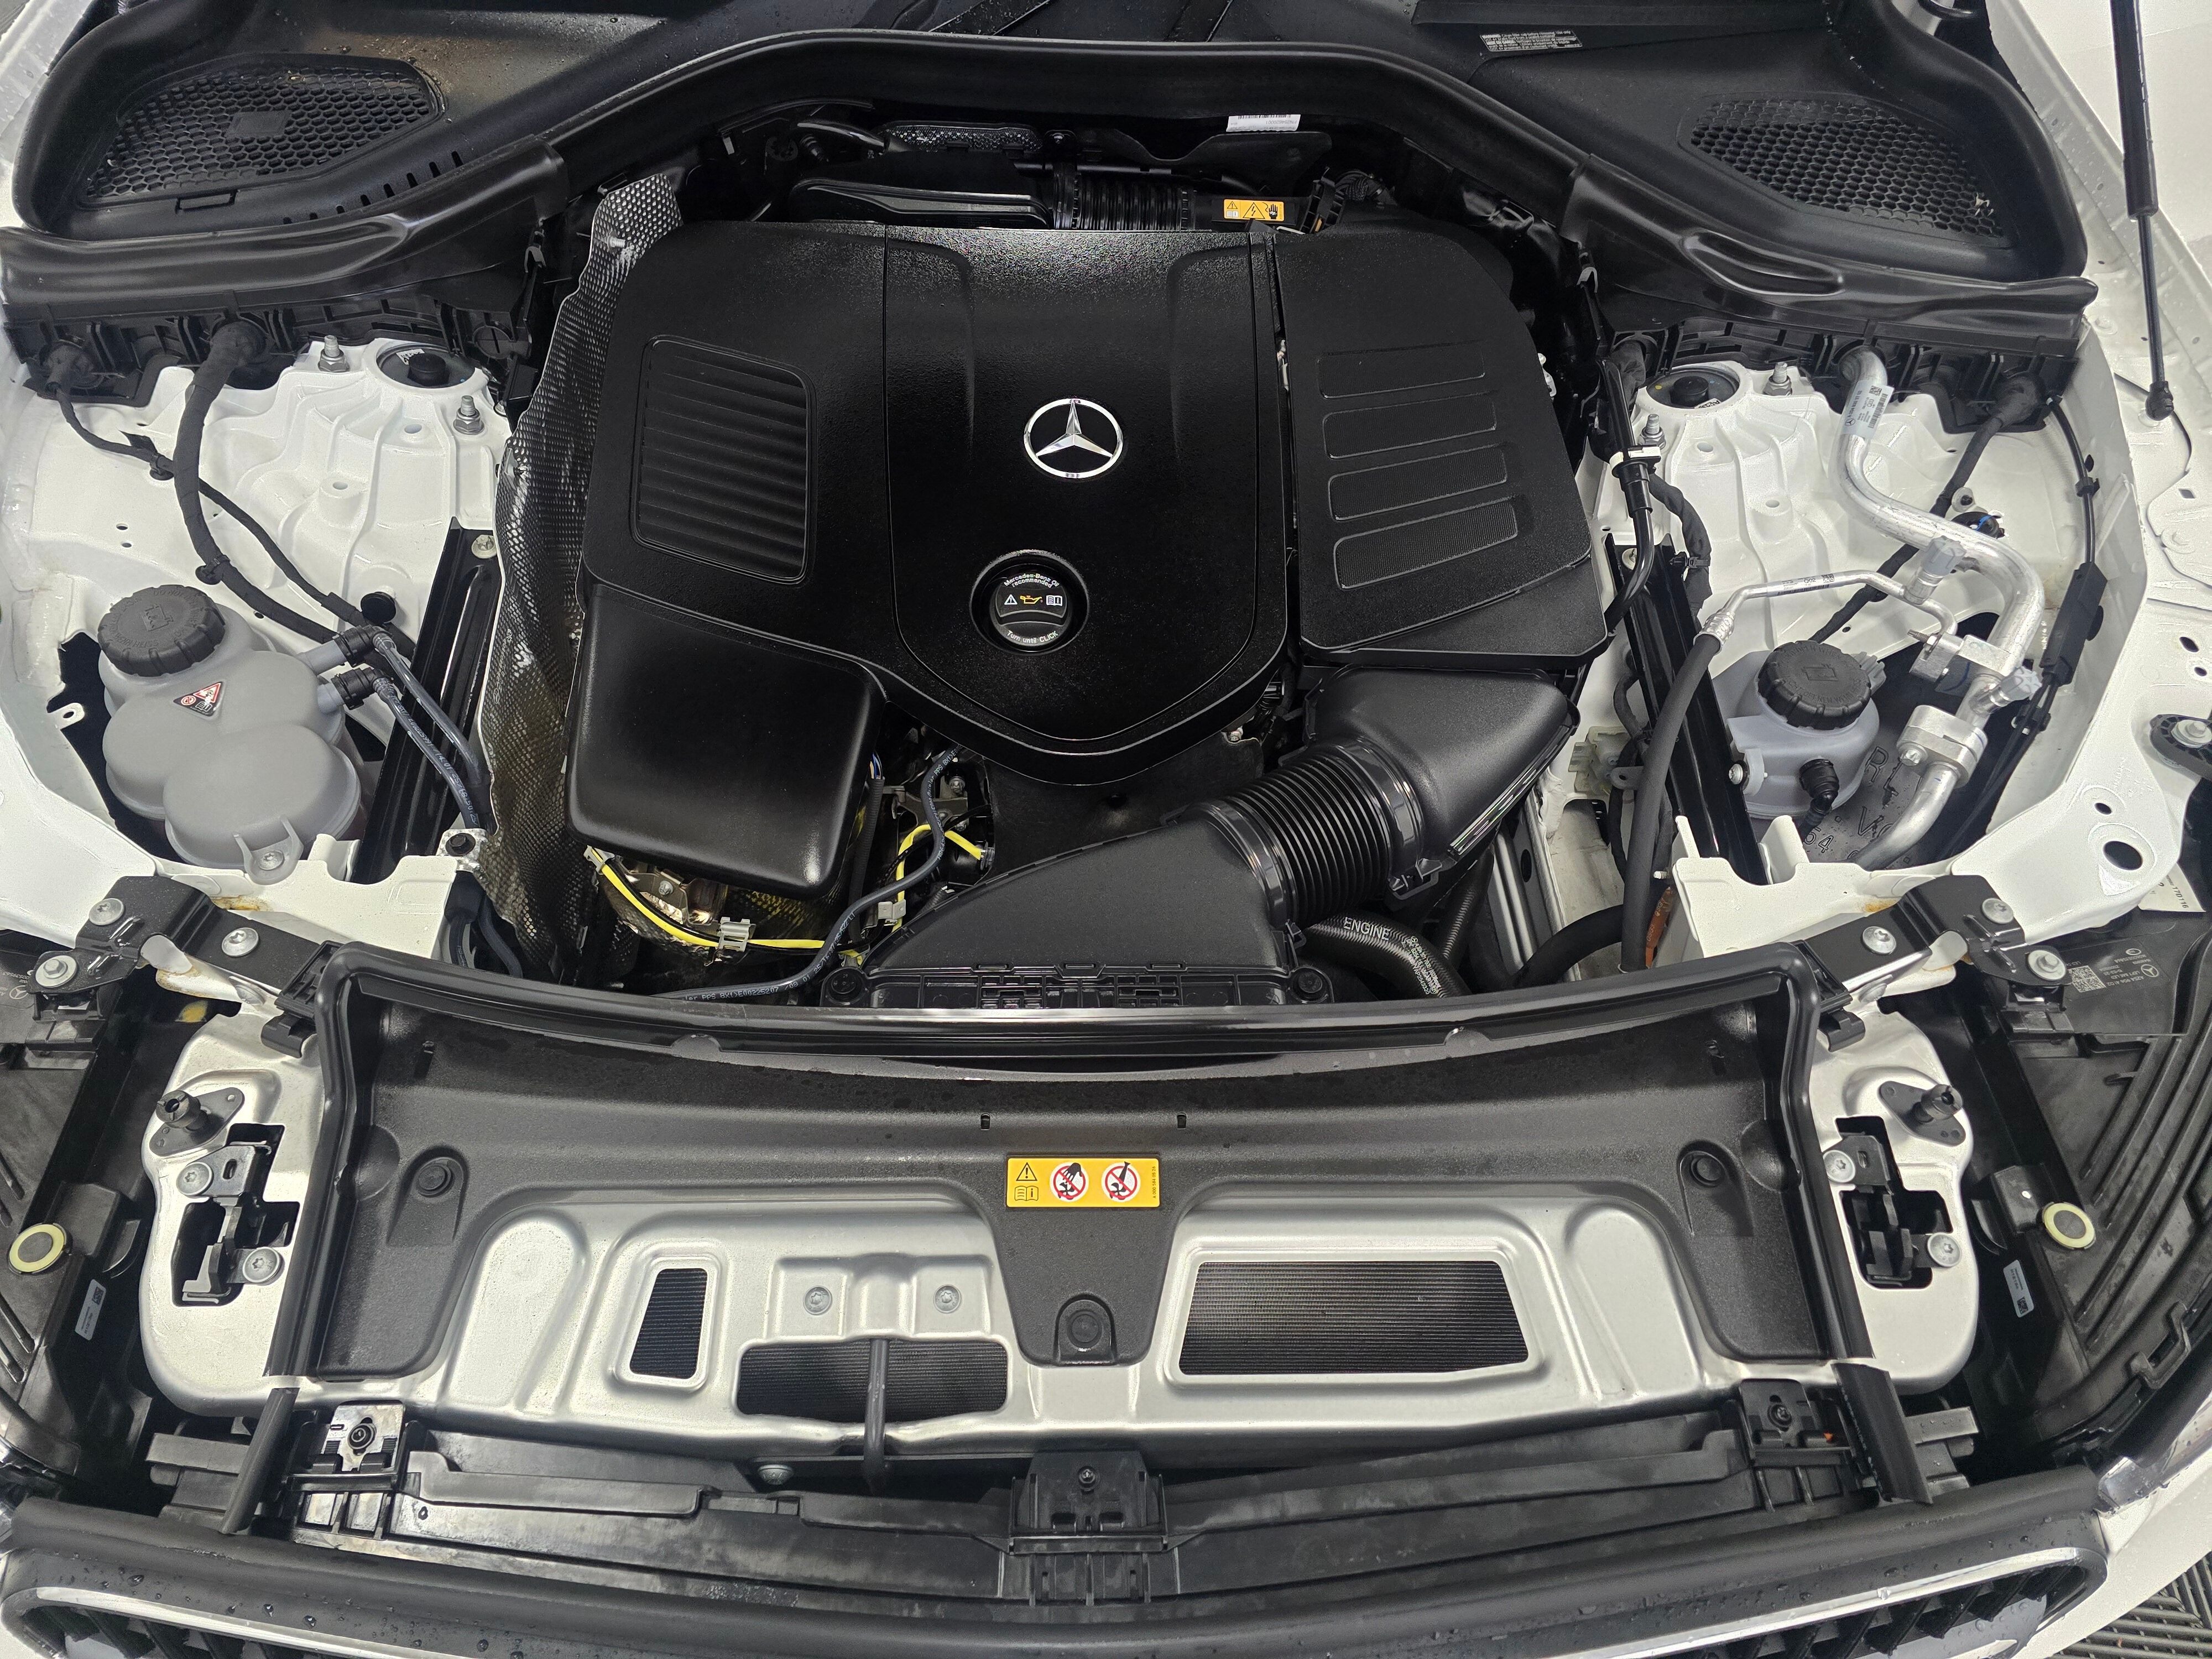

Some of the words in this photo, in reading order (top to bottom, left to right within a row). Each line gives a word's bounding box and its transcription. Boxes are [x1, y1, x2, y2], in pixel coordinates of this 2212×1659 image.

[1004, 573, 1050, 586] Mercedes-Benz
[1012, 578, 1052, 588] recommended
[1007, 630, 1020, 641] Turn
[1039, 630, 1058, 643] CLICK
[1344, 917, 1391, 941] ENGINE
